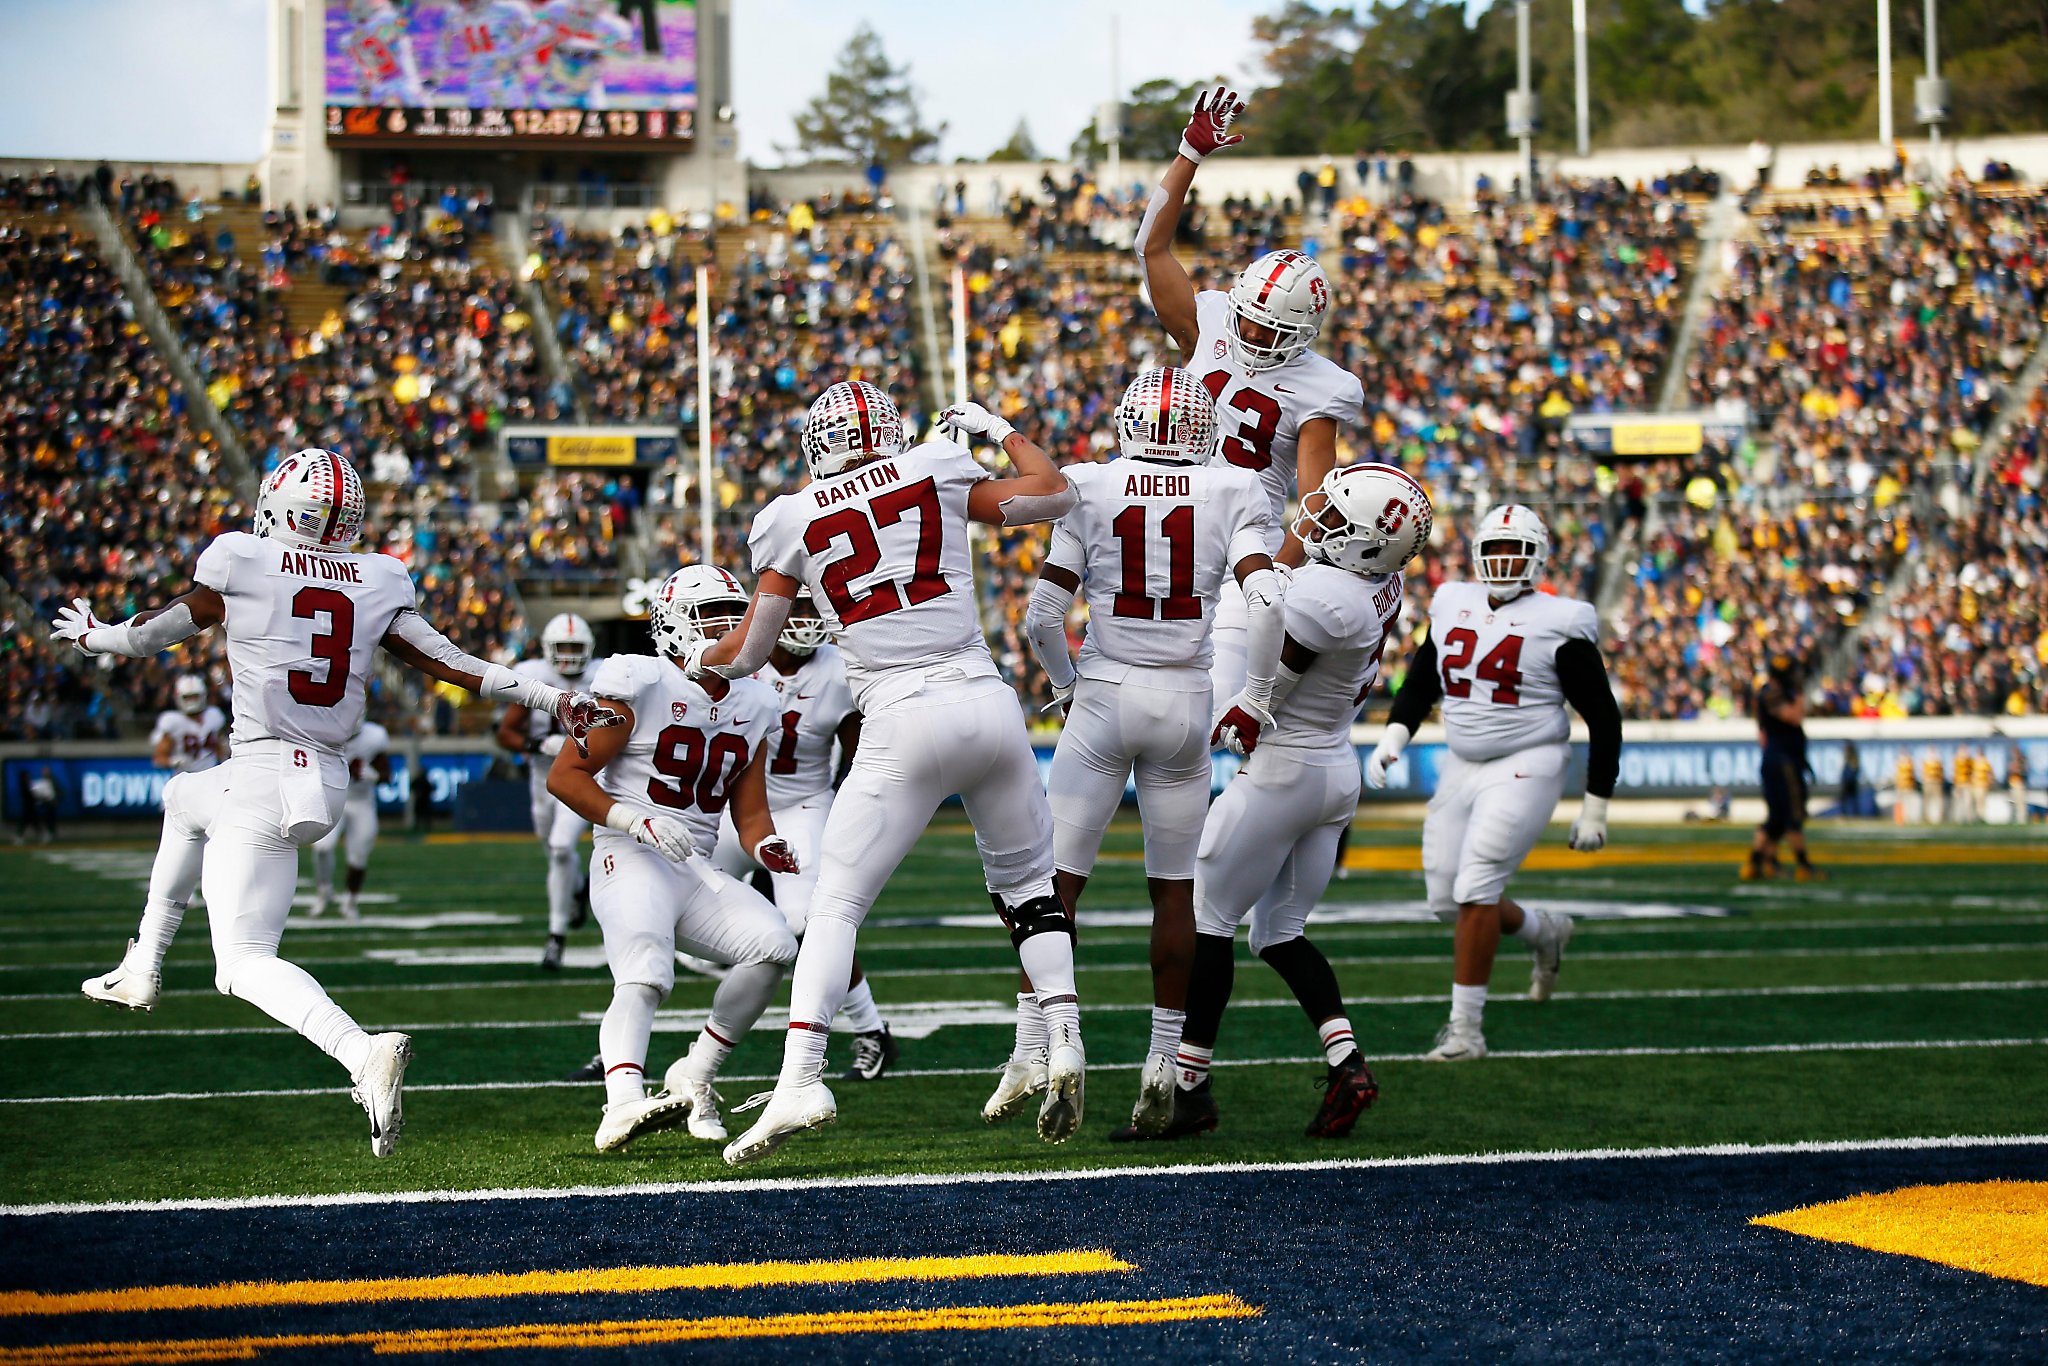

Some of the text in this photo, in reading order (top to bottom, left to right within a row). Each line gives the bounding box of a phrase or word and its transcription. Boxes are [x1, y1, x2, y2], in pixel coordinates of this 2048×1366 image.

[606, 112, 638, 135] 13
[1145, 448, 1179, 457] STANFORD
[813, 462, 901, 509] BARTON
[1124, 474, 1190, 496] ADEBO
[280, 551, 363, 584] ANTOINE
[803, 475, 952, 629] 27
[1112, 505, 1203, 620] 11
[288, 586, 355, 707] 3
[1442, 627, 1524, 705] 24
[82, 771, 174, 807] DOWN
[647, 724, 749, 814] 90
